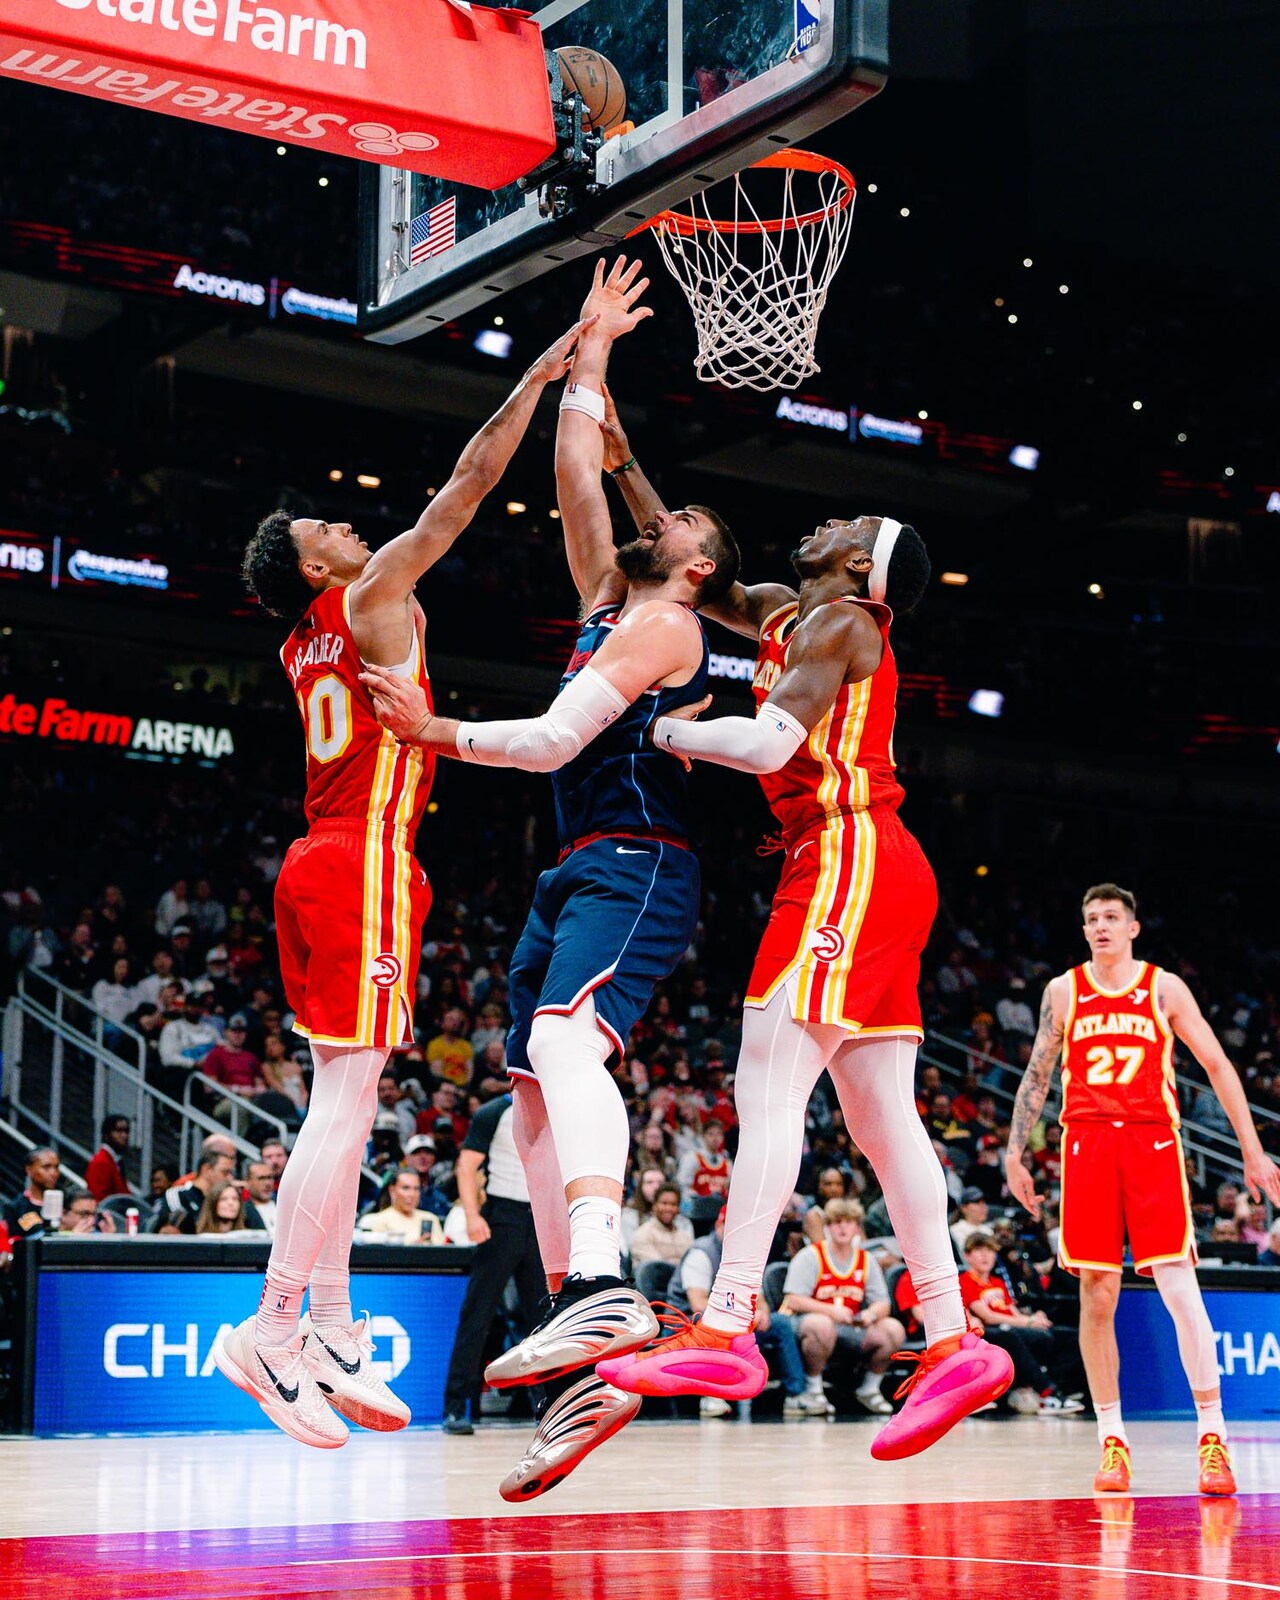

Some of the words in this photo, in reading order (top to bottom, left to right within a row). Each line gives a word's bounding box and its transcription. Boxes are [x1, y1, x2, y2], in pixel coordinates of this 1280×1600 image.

[173, 264, 265, 305] Acronis
[776, 396, 848, 431] Acronis
[0, 542, 44, 572] nis
[131, 717, 234, 759] ARENA
[1072, 1013, 1157, 1043] ATLANTA
[1085, 1045, 1145, 1085] 27
